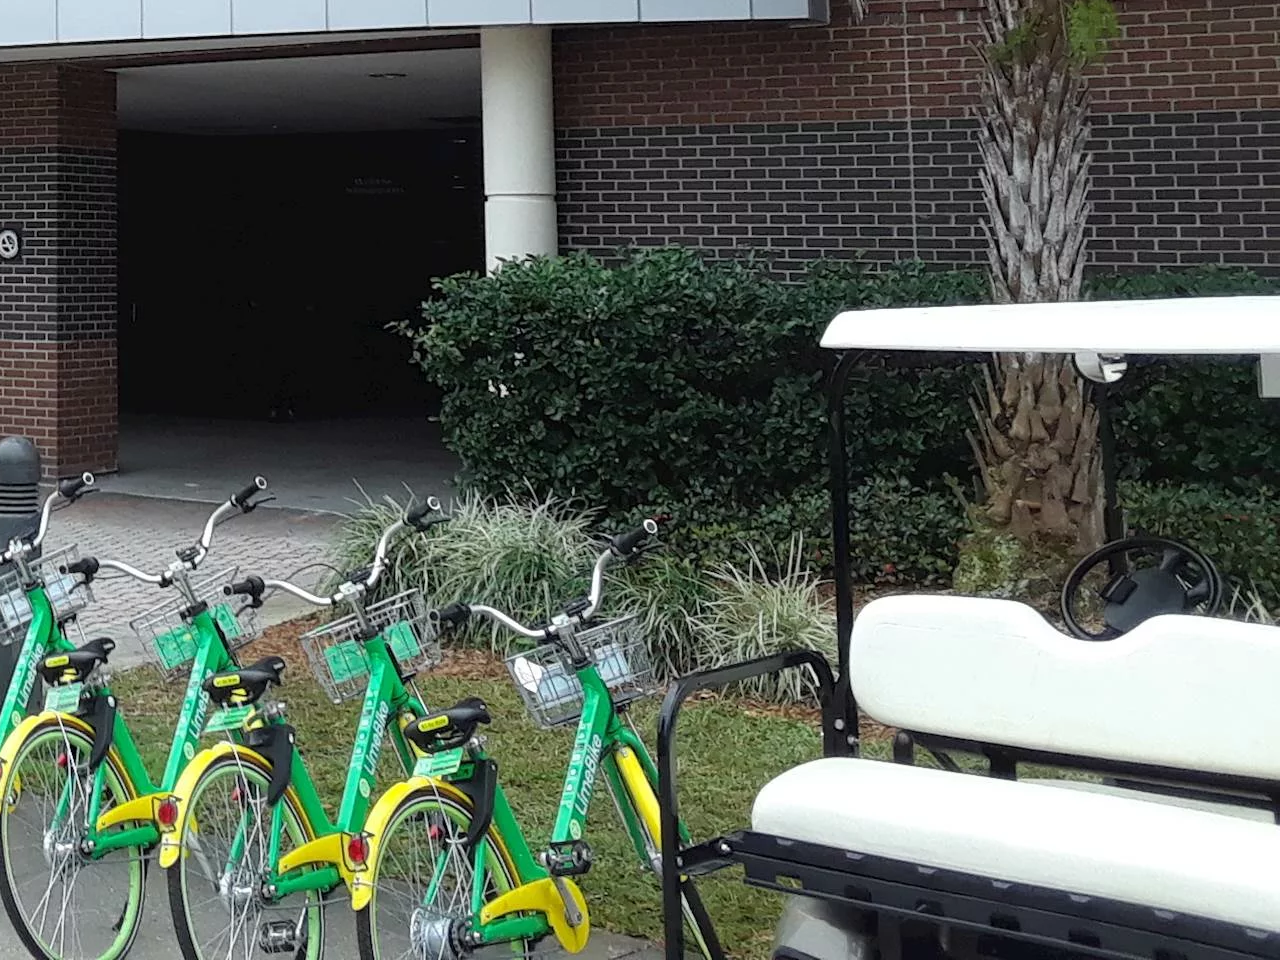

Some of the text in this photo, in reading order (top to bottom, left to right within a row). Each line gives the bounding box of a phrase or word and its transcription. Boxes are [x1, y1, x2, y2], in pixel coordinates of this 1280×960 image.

[17, 642, 45, 709] LimeBike
[363, 700, 390, 776] LimeBike
[574, 733, 602, 816] LimeBike
